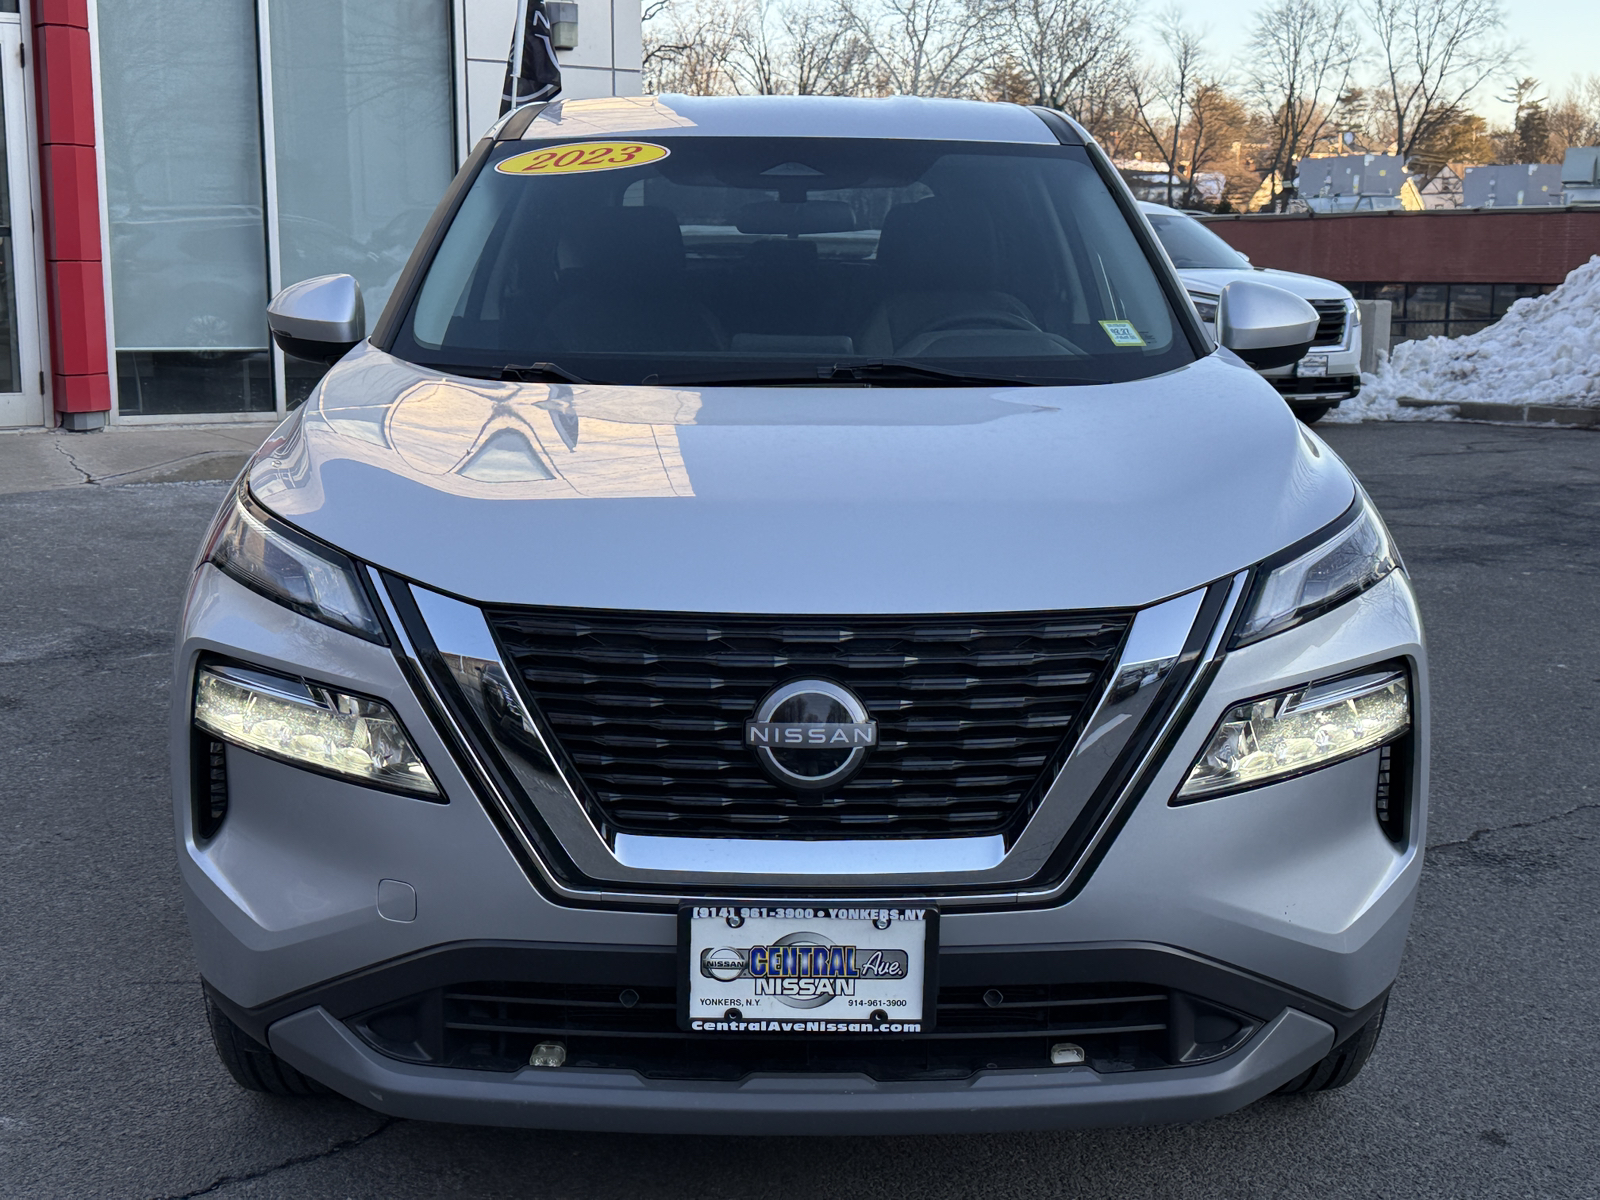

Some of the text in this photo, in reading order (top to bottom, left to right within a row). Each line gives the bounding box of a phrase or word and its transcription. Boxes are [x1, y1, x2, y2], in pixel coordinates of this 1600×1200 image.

[522, 146, 643, 171] 2023
[750, 726, 873, 744] NISSAN
[740, 907, 814, 919] 961-3900
[748, 945, 904, 978] CENTRAL Ave.
[755, 978, 855, 996] NISSAN
[700, 998, 744, 1007] YONKERS,
[691, 1021, 921, 1033] CentralAveNissan.com
